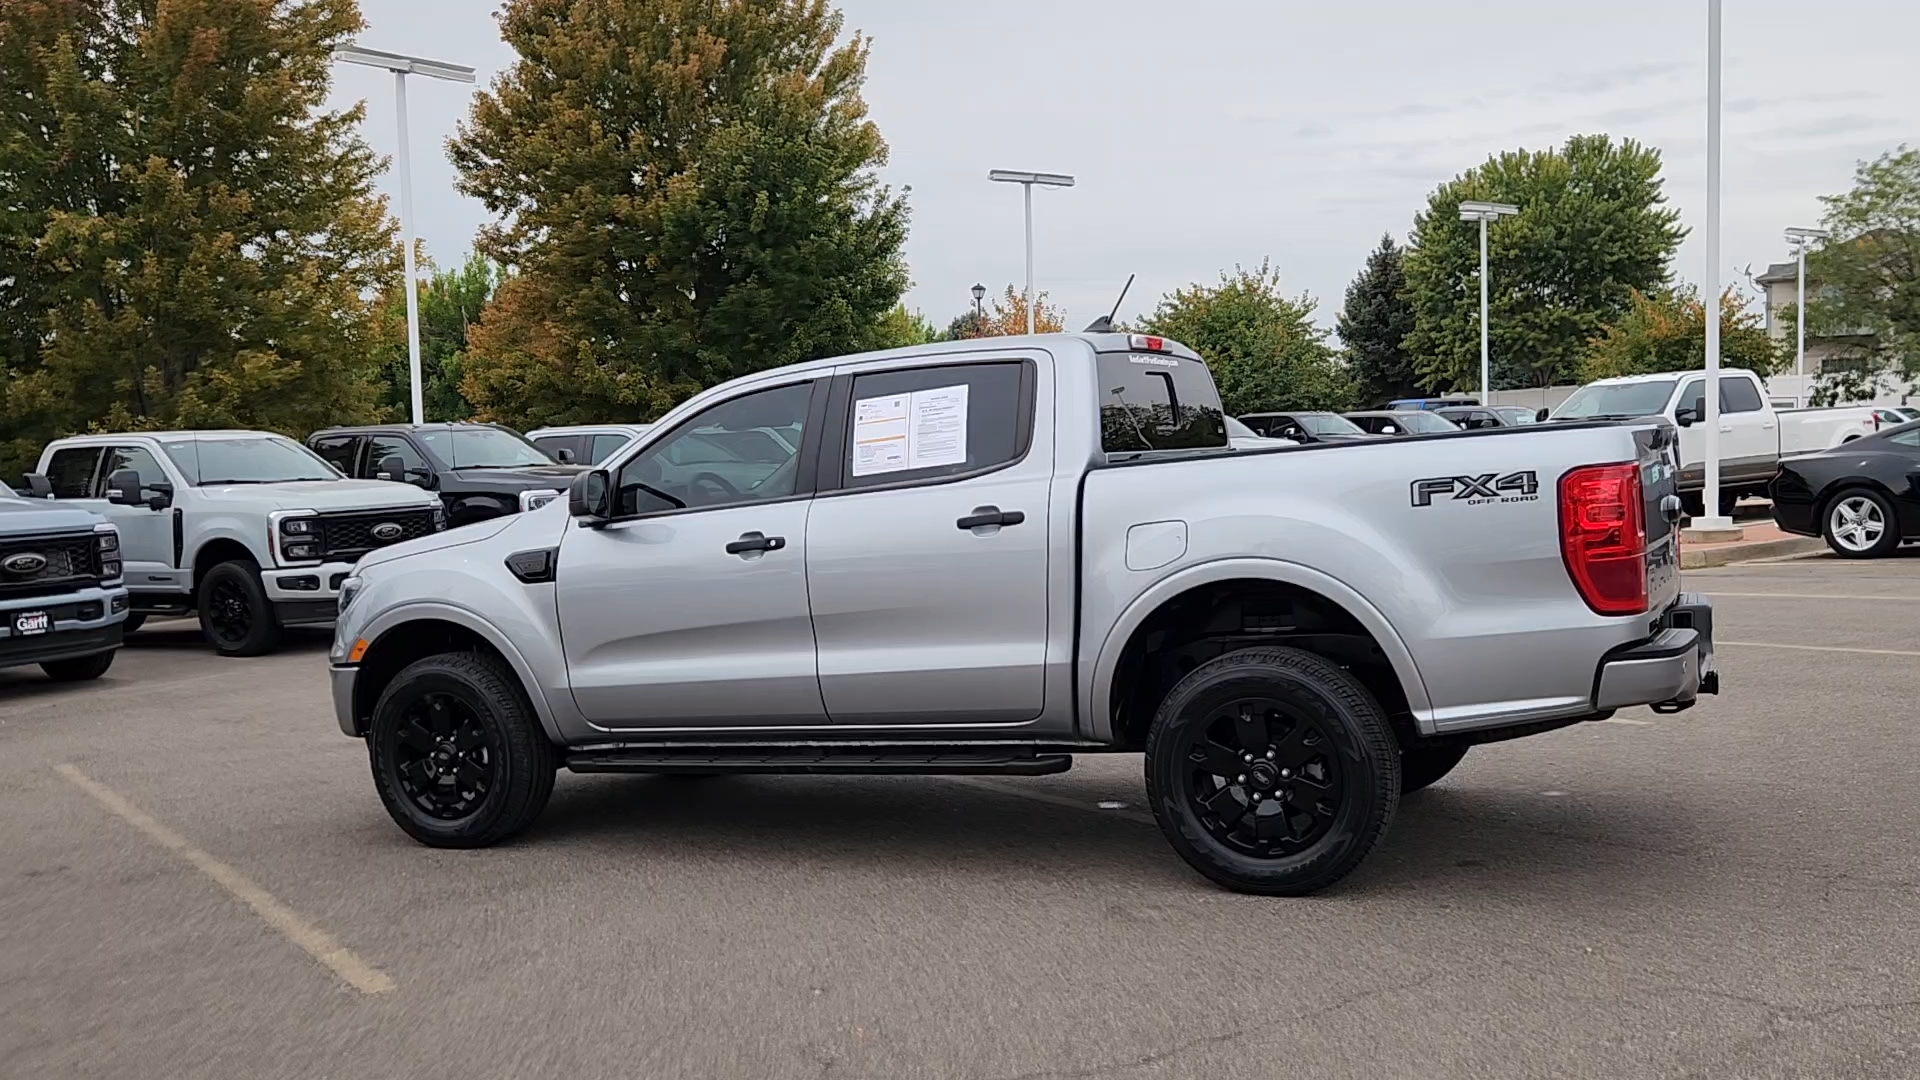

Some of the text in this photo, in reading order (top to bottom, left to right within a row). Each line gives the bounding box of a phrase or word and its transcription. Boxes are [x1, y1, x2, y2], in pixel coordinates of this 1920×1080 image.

[1410, 471, 1538, 507] FX4
[1467, 495, 1539, 506] OFF ROAD
